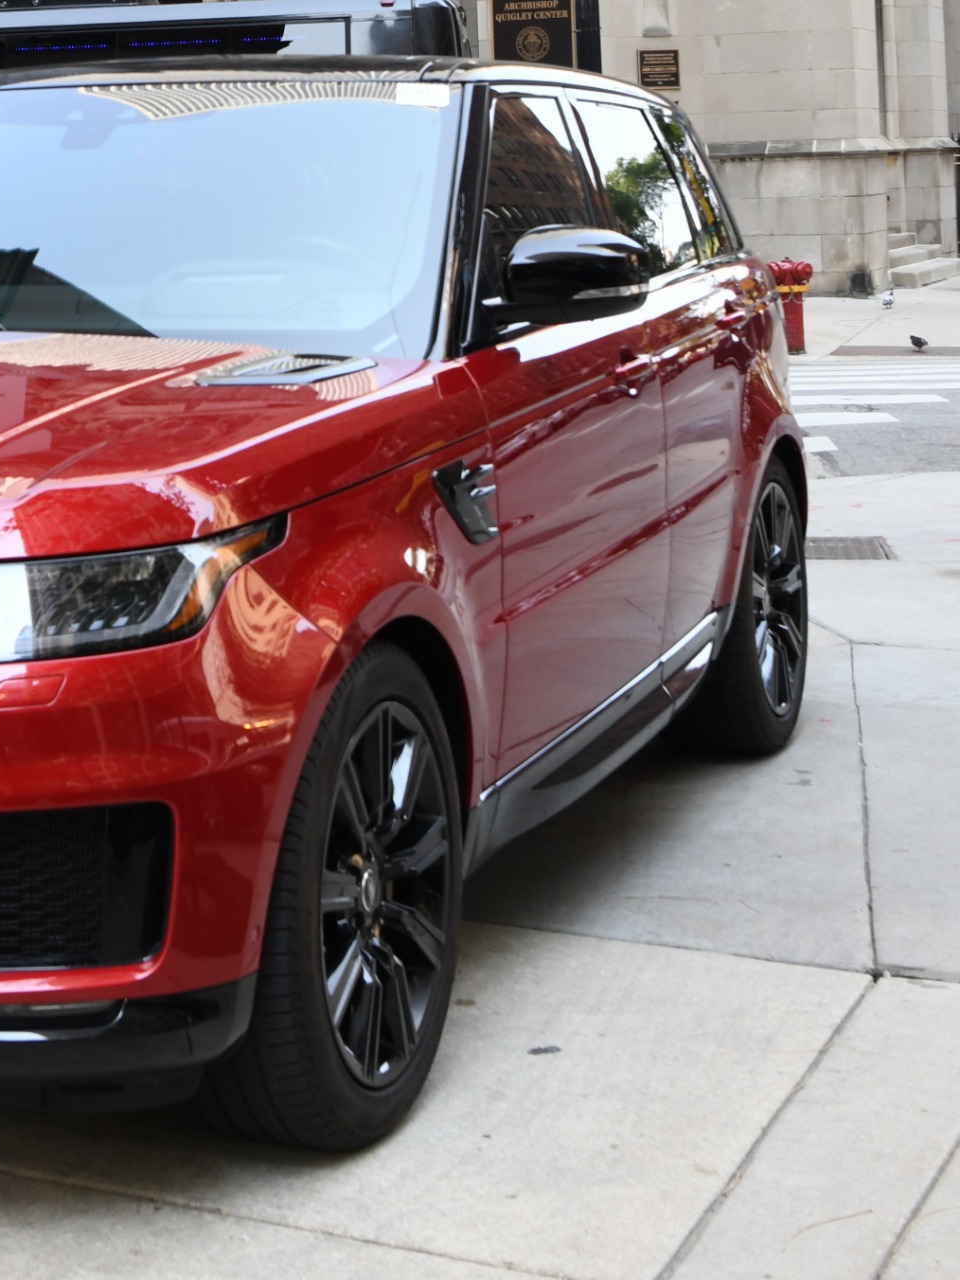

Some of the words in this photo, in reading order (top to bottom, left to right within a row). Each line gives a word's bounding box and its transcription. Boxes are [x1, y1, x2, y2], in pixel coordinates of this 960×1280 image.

[503, 0, 560, 11] ARCHBISHOP
[495, 11, 533, 23] QUIGLEY
[533, 9, 569, 20] CENTER
